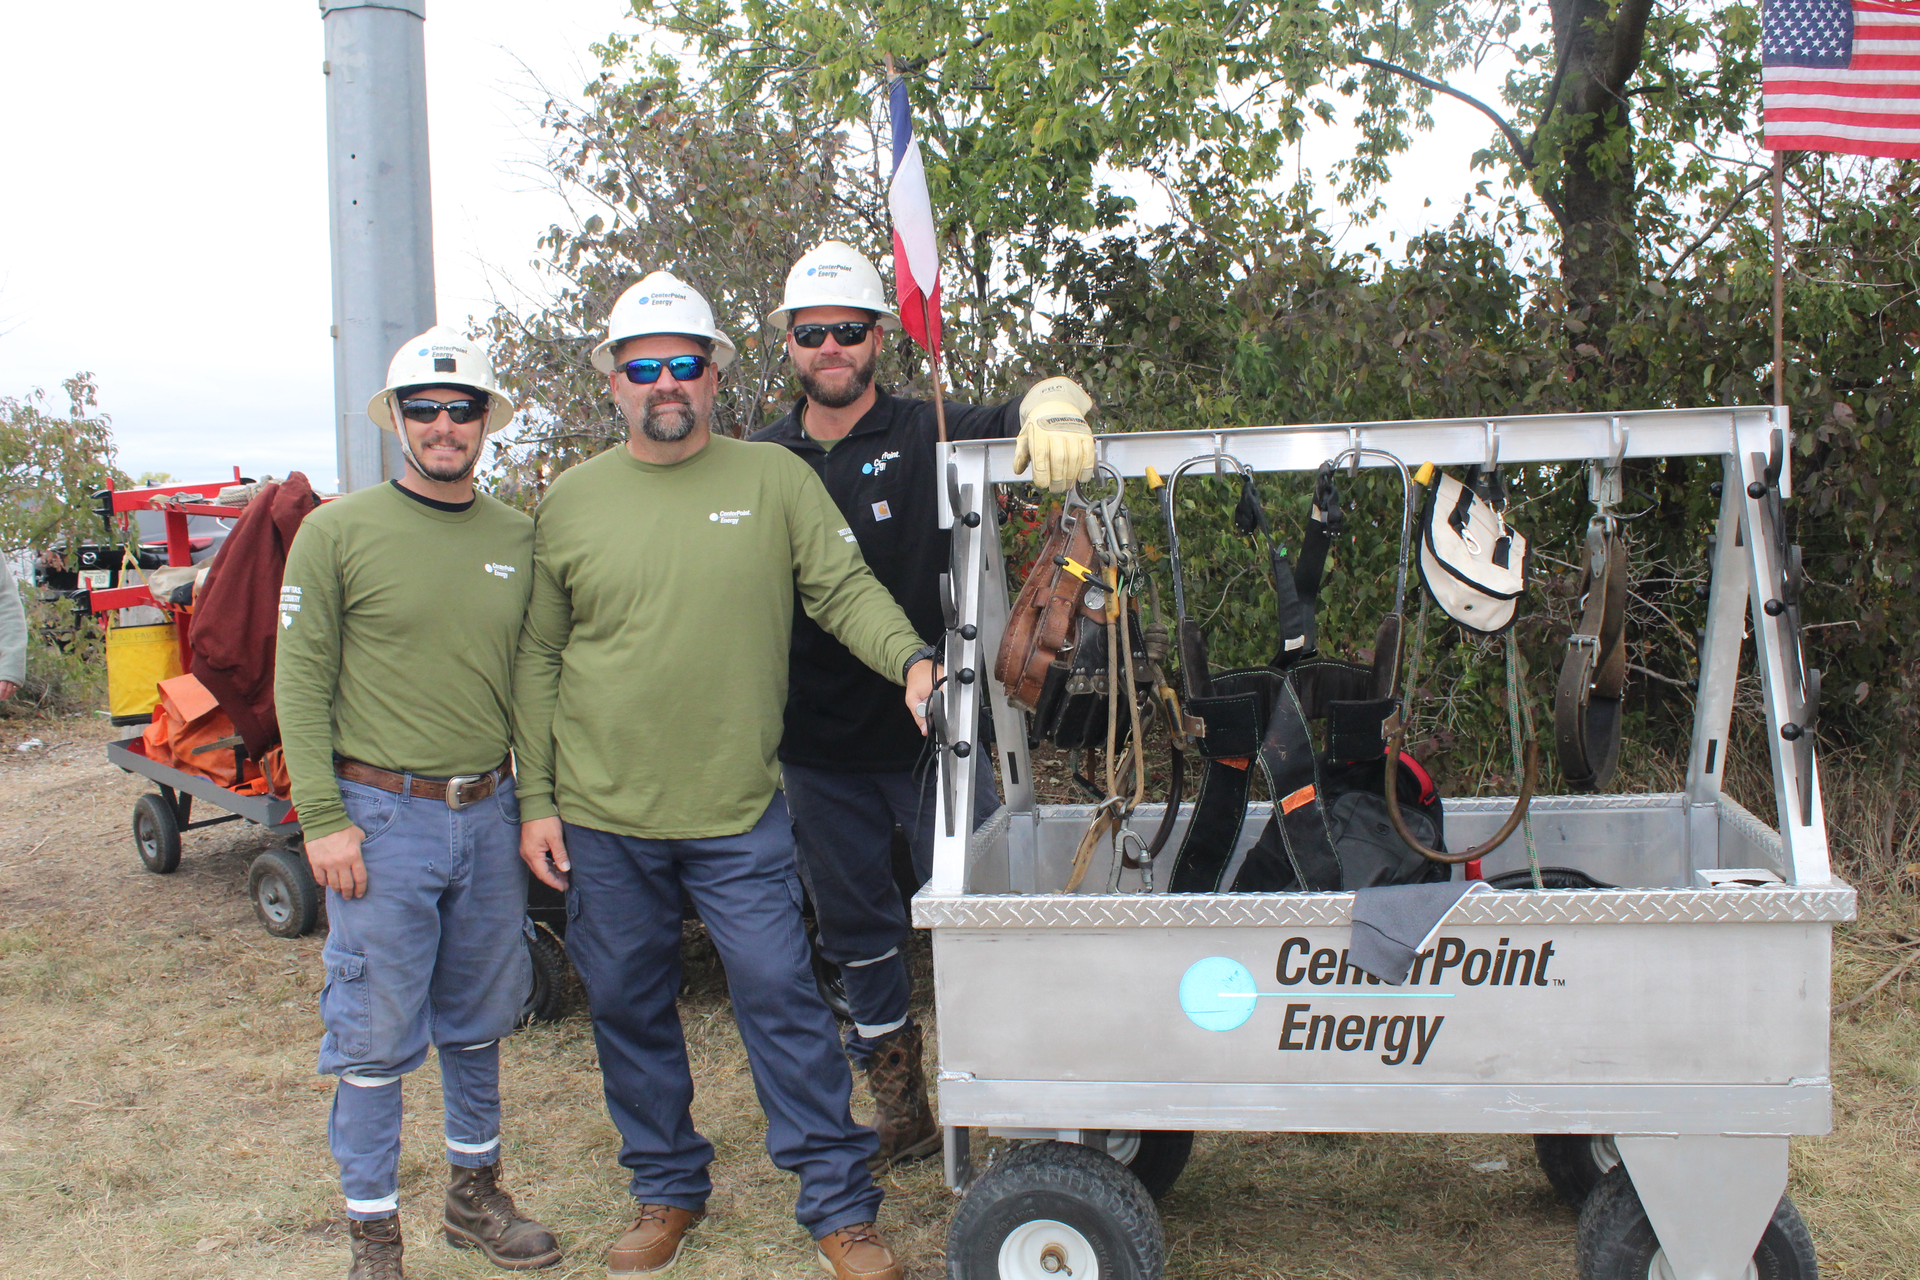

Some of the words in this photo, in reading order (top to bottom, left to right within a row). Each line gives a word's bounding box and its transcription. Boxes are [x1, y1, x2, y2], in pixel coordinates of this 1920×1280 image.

[818, 264, 852, 272] CenterPoint
[431, 345, 468, 354] CenterPoint
[720, 517, 740, 525] Energy
[1275, 936, 1555, 987] CenrPoint
[1278, 1003, 1445, 1066] Energy
